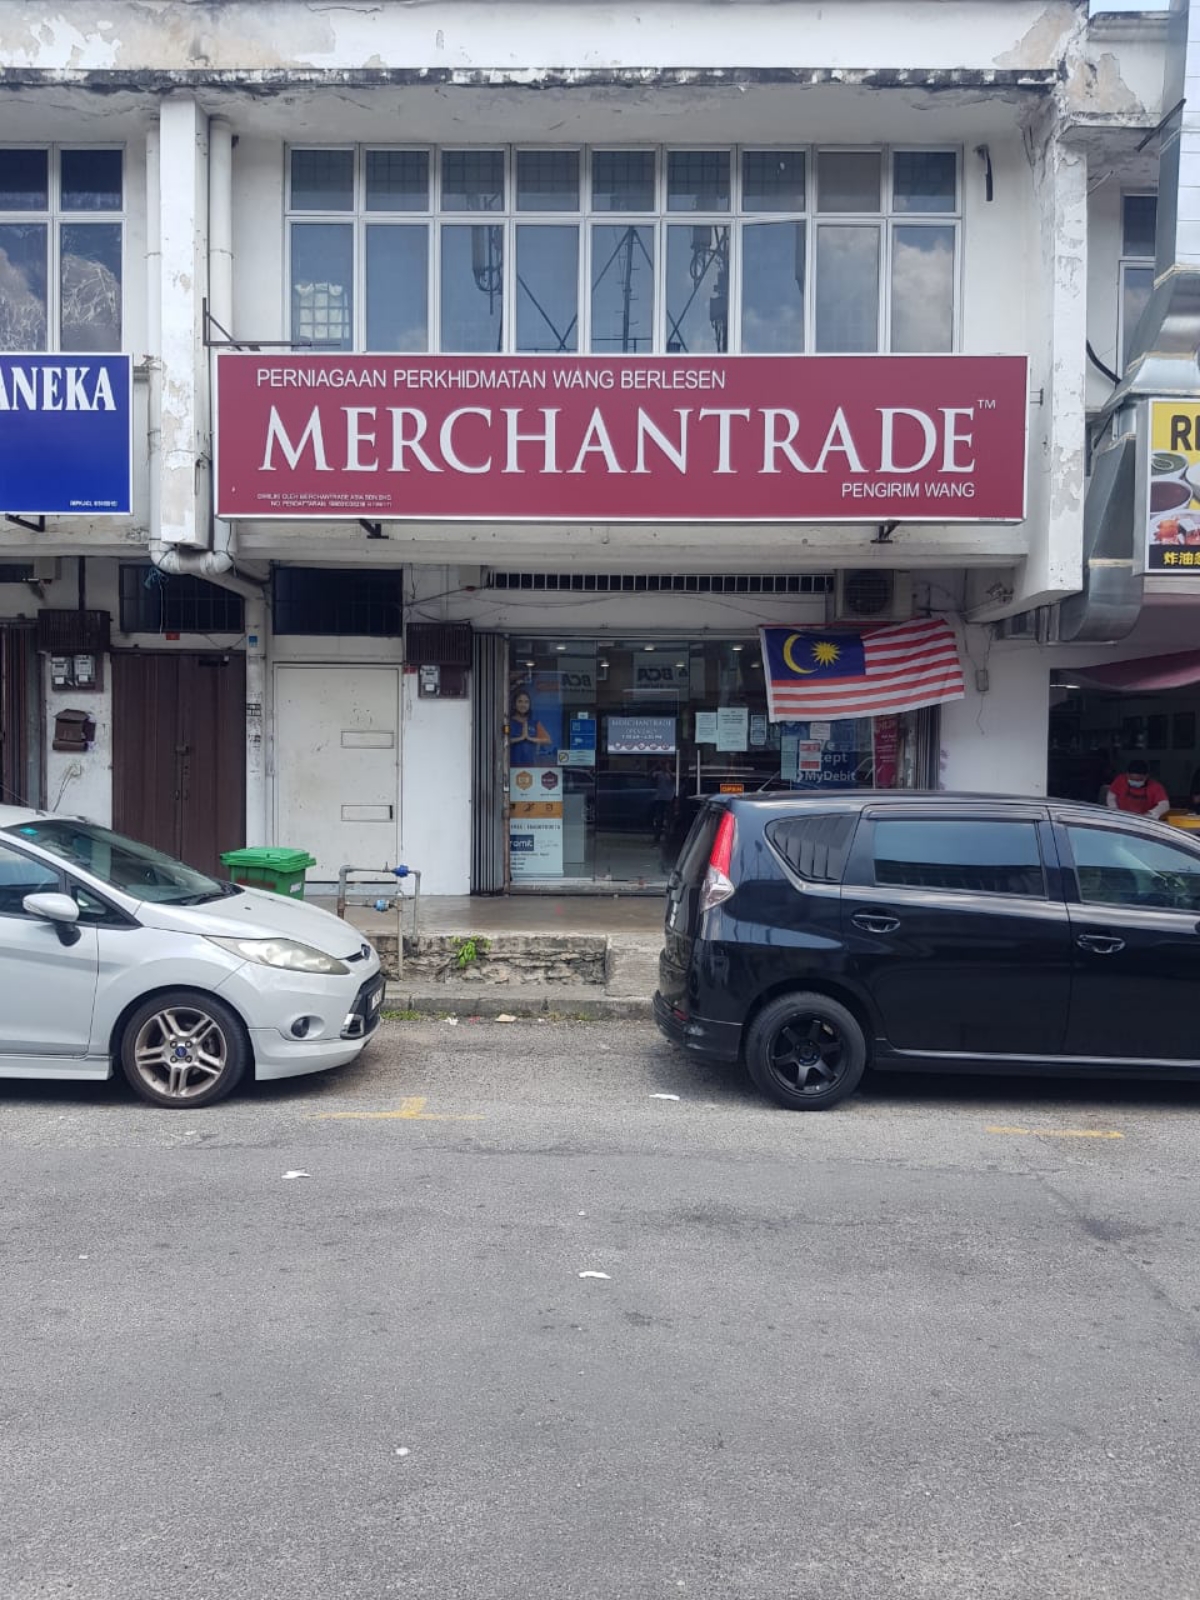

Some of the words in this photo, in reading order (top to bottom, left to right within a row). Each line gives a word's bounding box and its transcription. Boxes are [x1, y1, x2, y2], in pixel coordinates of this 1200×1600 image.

[256, 368, 387, 388] PERNIAGAAN
[393, 369, 546, 389] PERKHIDMATAN
[552, 369, 615, 389] WANG
[620, 369, 726, 390] BERLESEN
[259, 405, 975, 475] MERCHANTRADE
[841, 482, 920, 498] PENGIRIM
[924, 482, 975, 498] WANG
[804, 770, 857, 784] MyDebit
